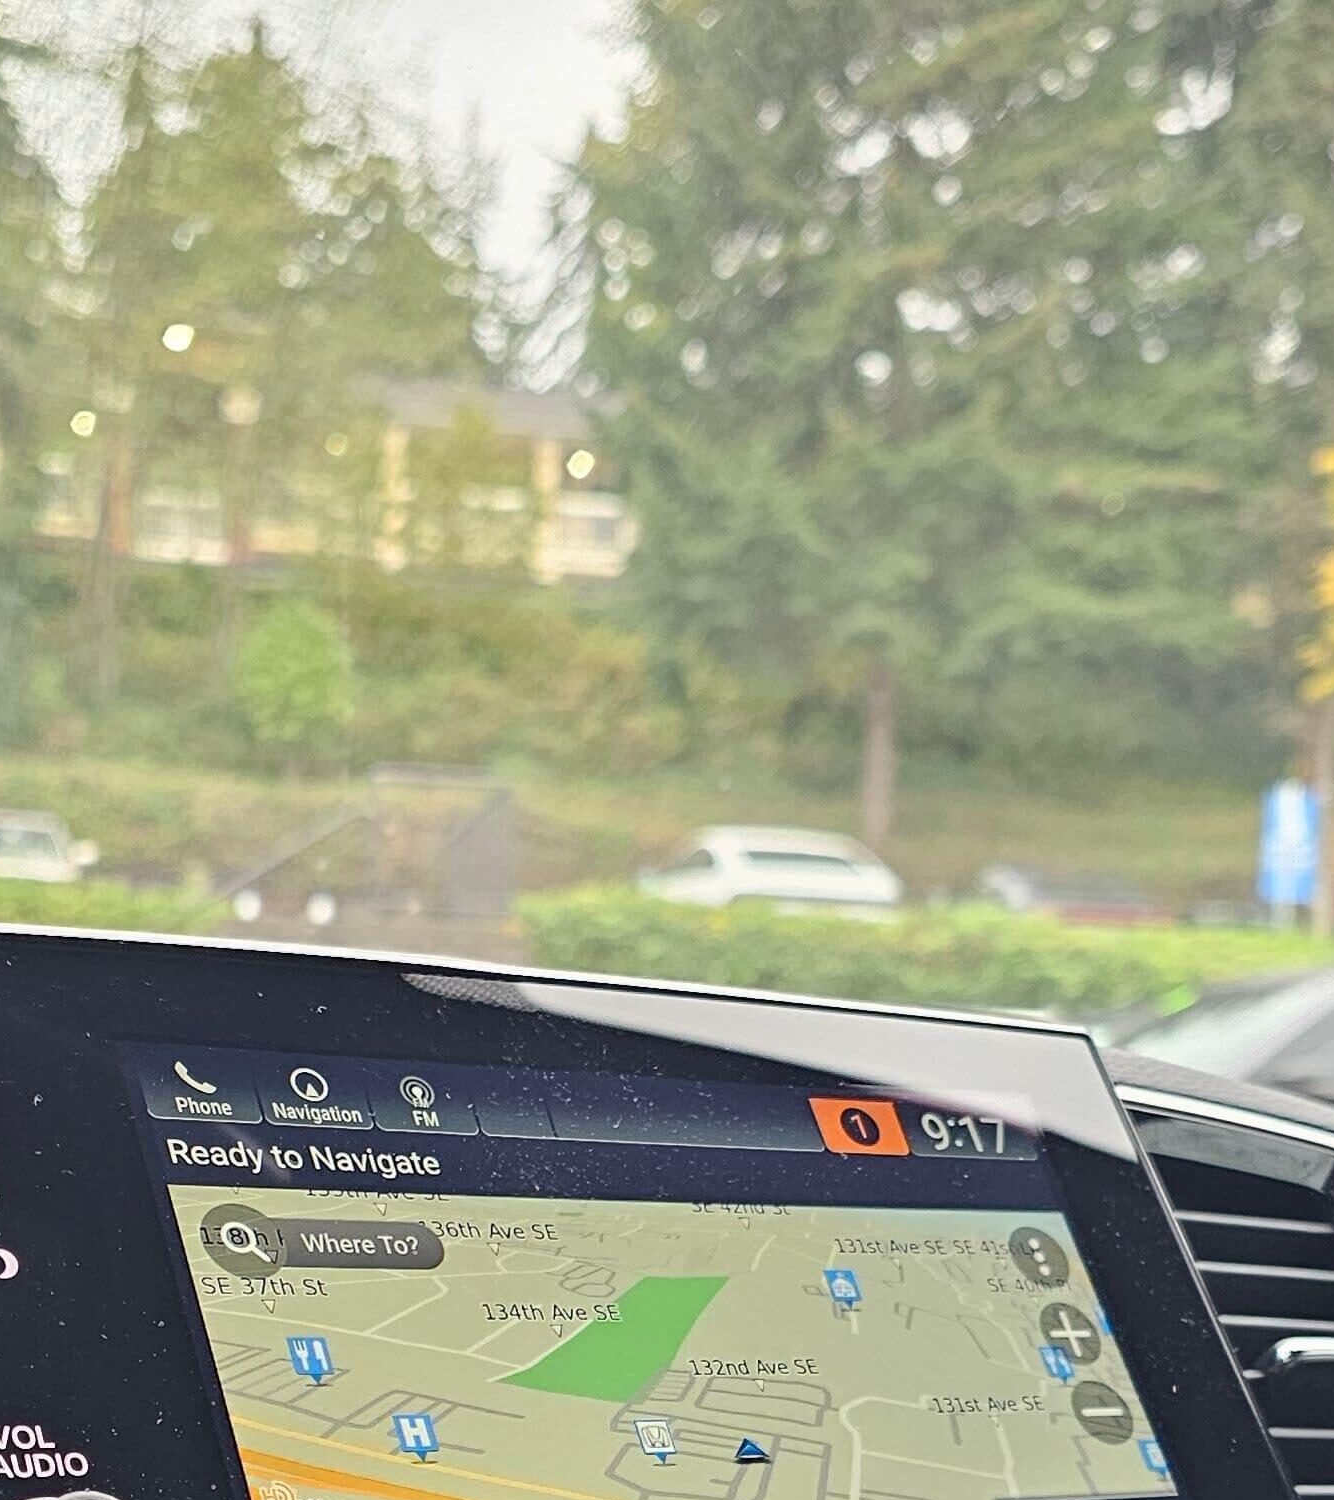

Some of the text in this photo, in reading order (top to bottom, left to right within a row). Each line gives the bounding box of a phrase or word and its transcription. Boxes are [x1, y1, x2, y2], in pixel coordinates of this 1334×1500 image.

[174, 1096, 233, 1117] Phone
[272, 1102, 363, 1124] Navigation
[412, 1110, 440, 1127] FM
[921, 1112, 1004, 1154] 9:17
[167, 1138, 441, 1180] Ready to Navigate
[489, 1224, 524, 1240] Ave
[531, 1225, 559, 1240] SE
[300, 1232, 375, 1255] Where
[384, 1236, 419, 1256] To?
[834, 1239, 947, 1255] 131st Ave SE
[954, 1240, 976, 1254] SE
[201, 1277, 328, 1297] SE 37th St
[987, 1278, 1008, 1293] SE
[482, 1303, 621, 1321] 134th Ave SE
[689, 1359, 819, 1377] 132nd Ave SE
[932, 1395, 1045, 1414] 131st Ave SE
